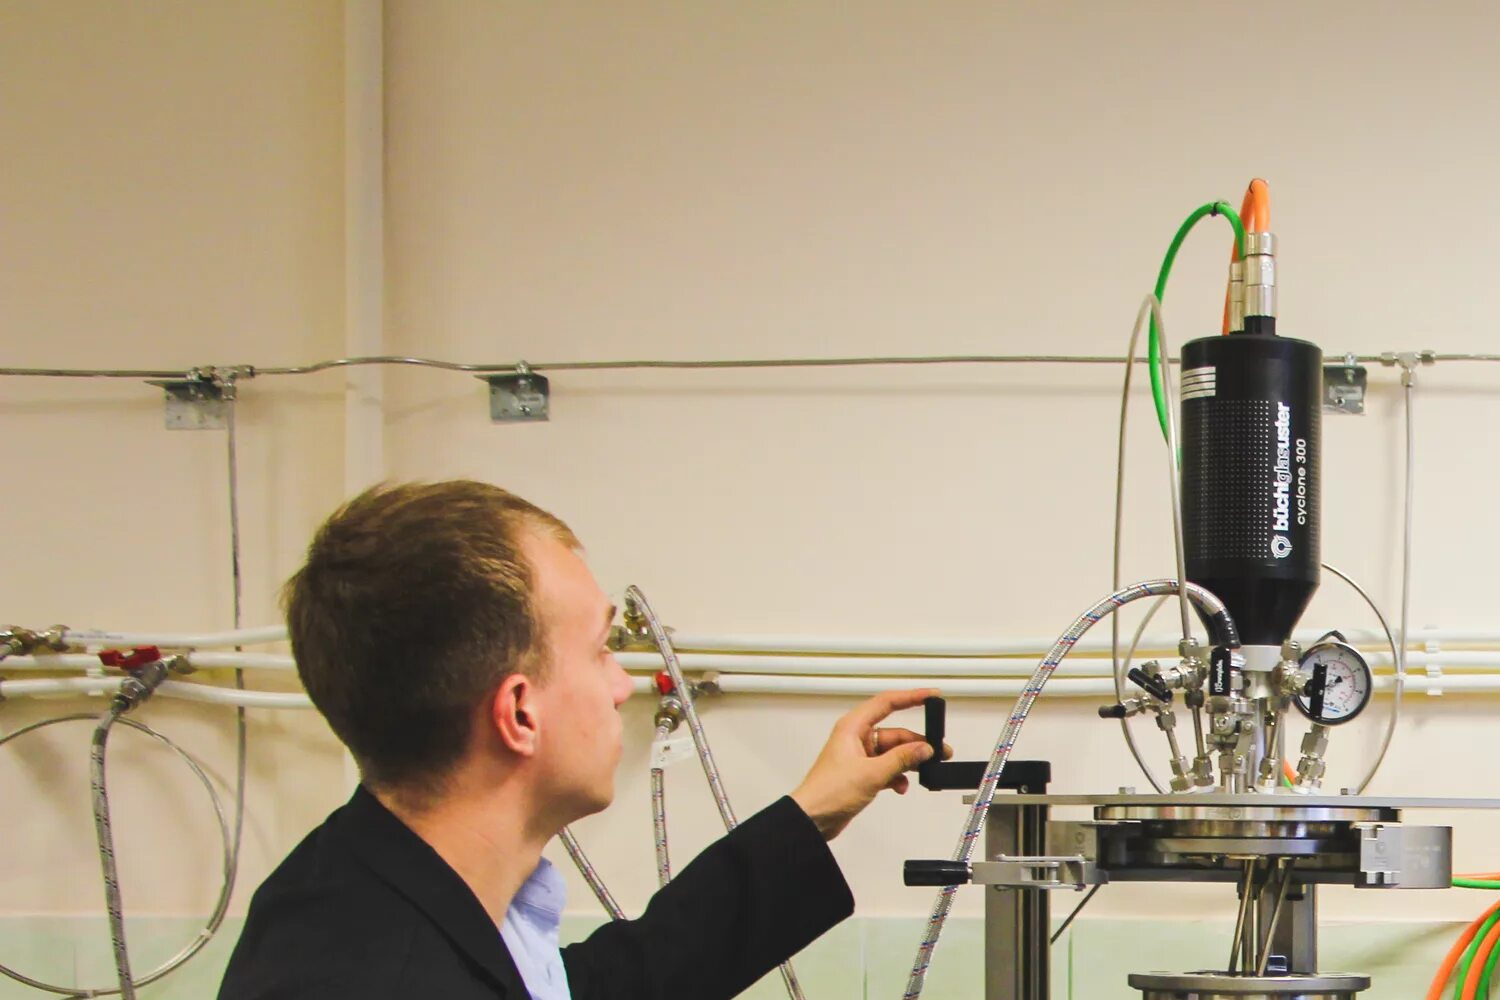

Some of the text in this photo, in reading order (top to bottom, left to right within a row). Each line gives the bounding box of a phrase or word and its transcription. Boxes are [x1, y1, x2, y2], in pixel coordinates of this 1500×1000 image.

[1273, 401, 1292, 531] büchiglasuster
[1296, 438, 1307, 525] cyclone 300
